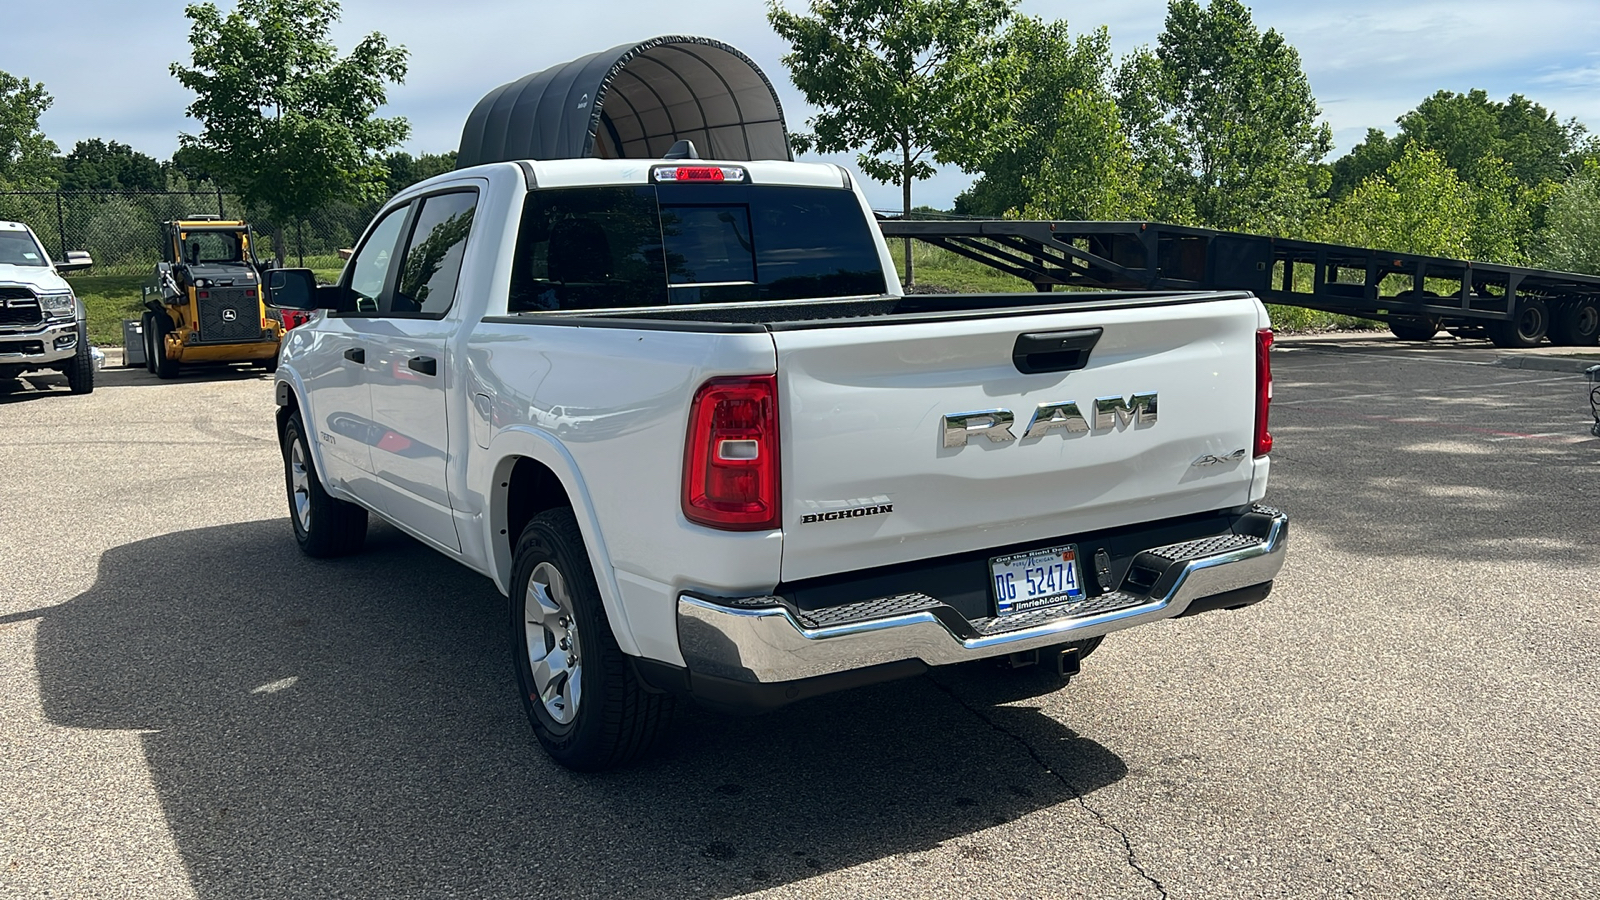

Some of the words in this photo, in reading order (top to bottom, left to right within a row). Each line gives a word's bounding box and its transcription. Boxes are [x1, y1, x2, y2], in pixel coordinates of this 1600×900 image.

[942, 390, 1159, 448] RAM
[802, 504, 894, 524] BIGHORN
[995, 572, 1017, 602] DG
[1025, 562, 1075, 596] 52474
[1015, 594, 1068, 611] jimriehl.com
